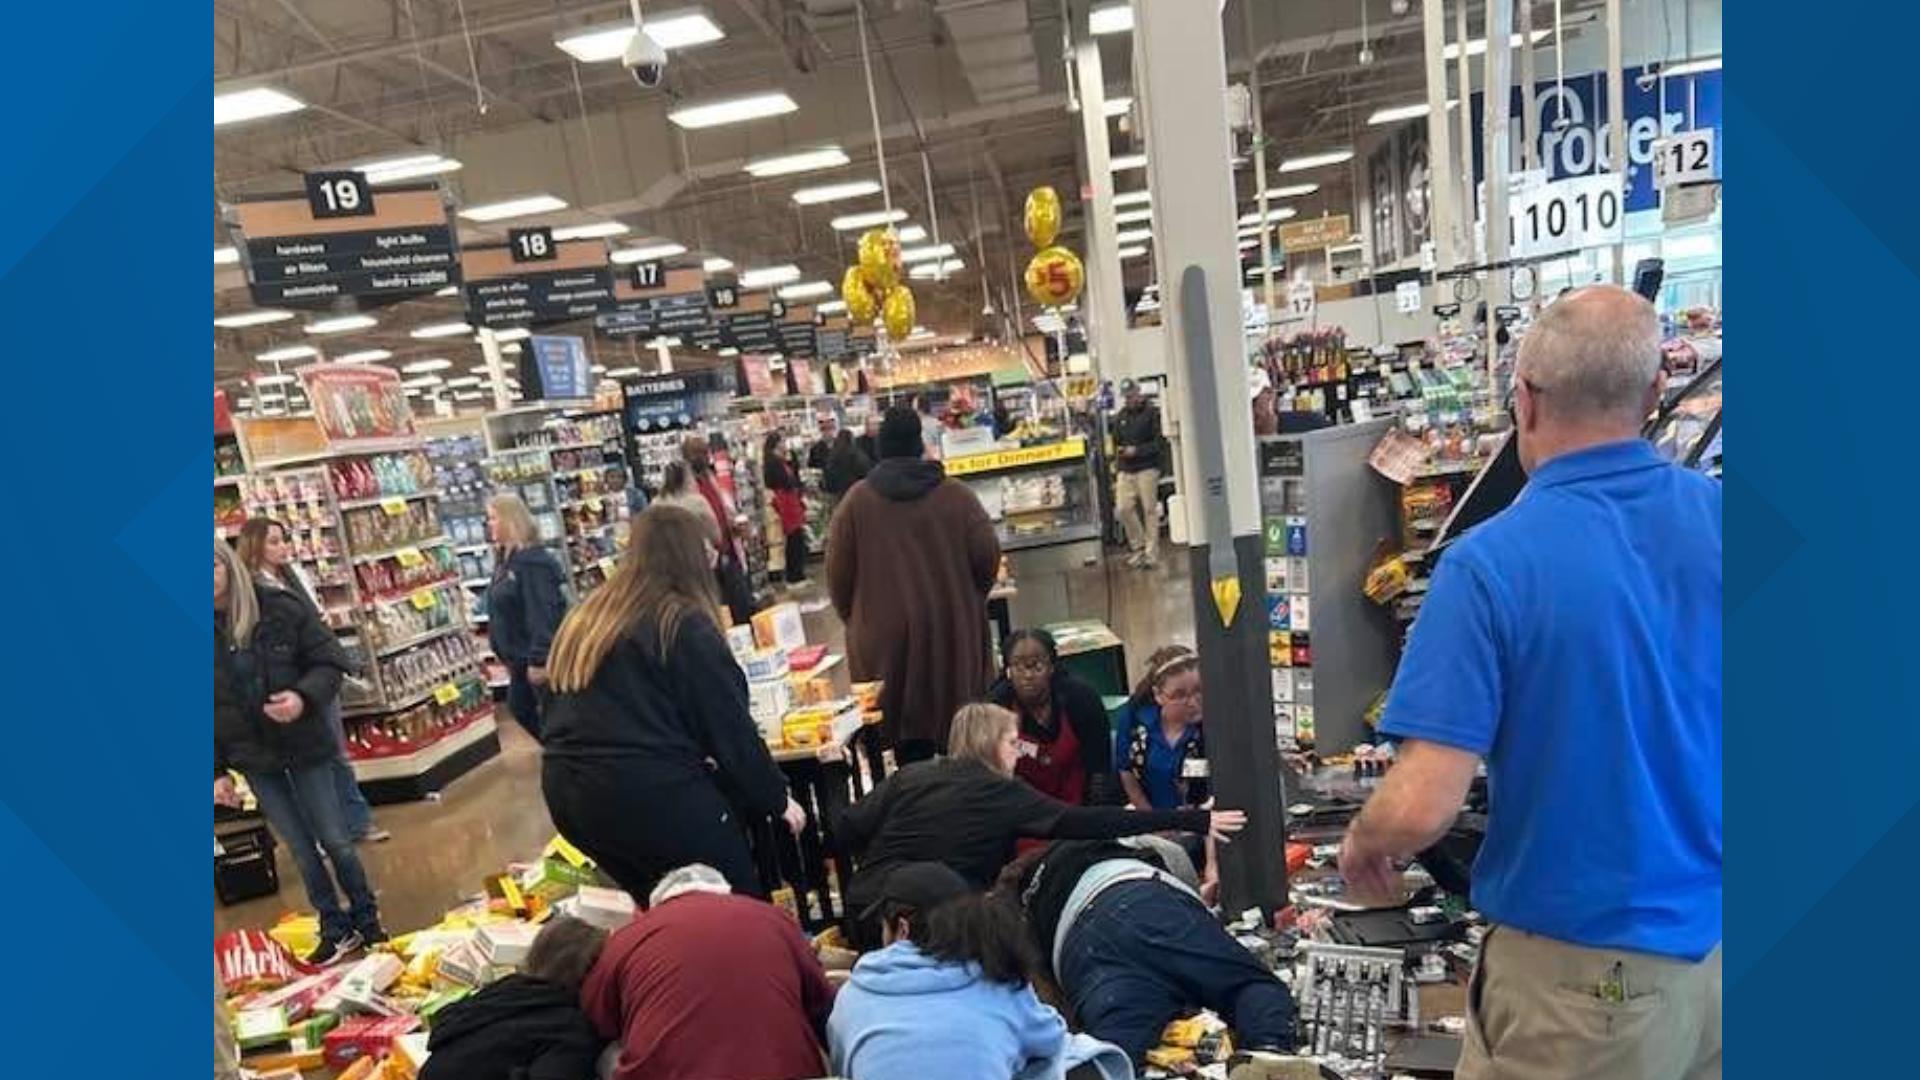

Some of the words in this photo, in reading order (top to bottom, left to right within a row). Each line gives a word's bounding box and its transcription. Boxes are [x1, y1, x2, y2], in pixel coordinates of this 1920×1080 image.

[1671, 139, 1709, 173] 12
[320, 179, 360, 211] 19
[1526, 198, 1567, 241] 10
[1576, 190, 1617, 232] 10
[518, 232, 547, 257] 18
[637, 263, 657, 286] 17
[716, 287, 734, 305] 16
[1293, 298, 1311, 314] 17
[626, 378, 686, 397] BATTERIES
